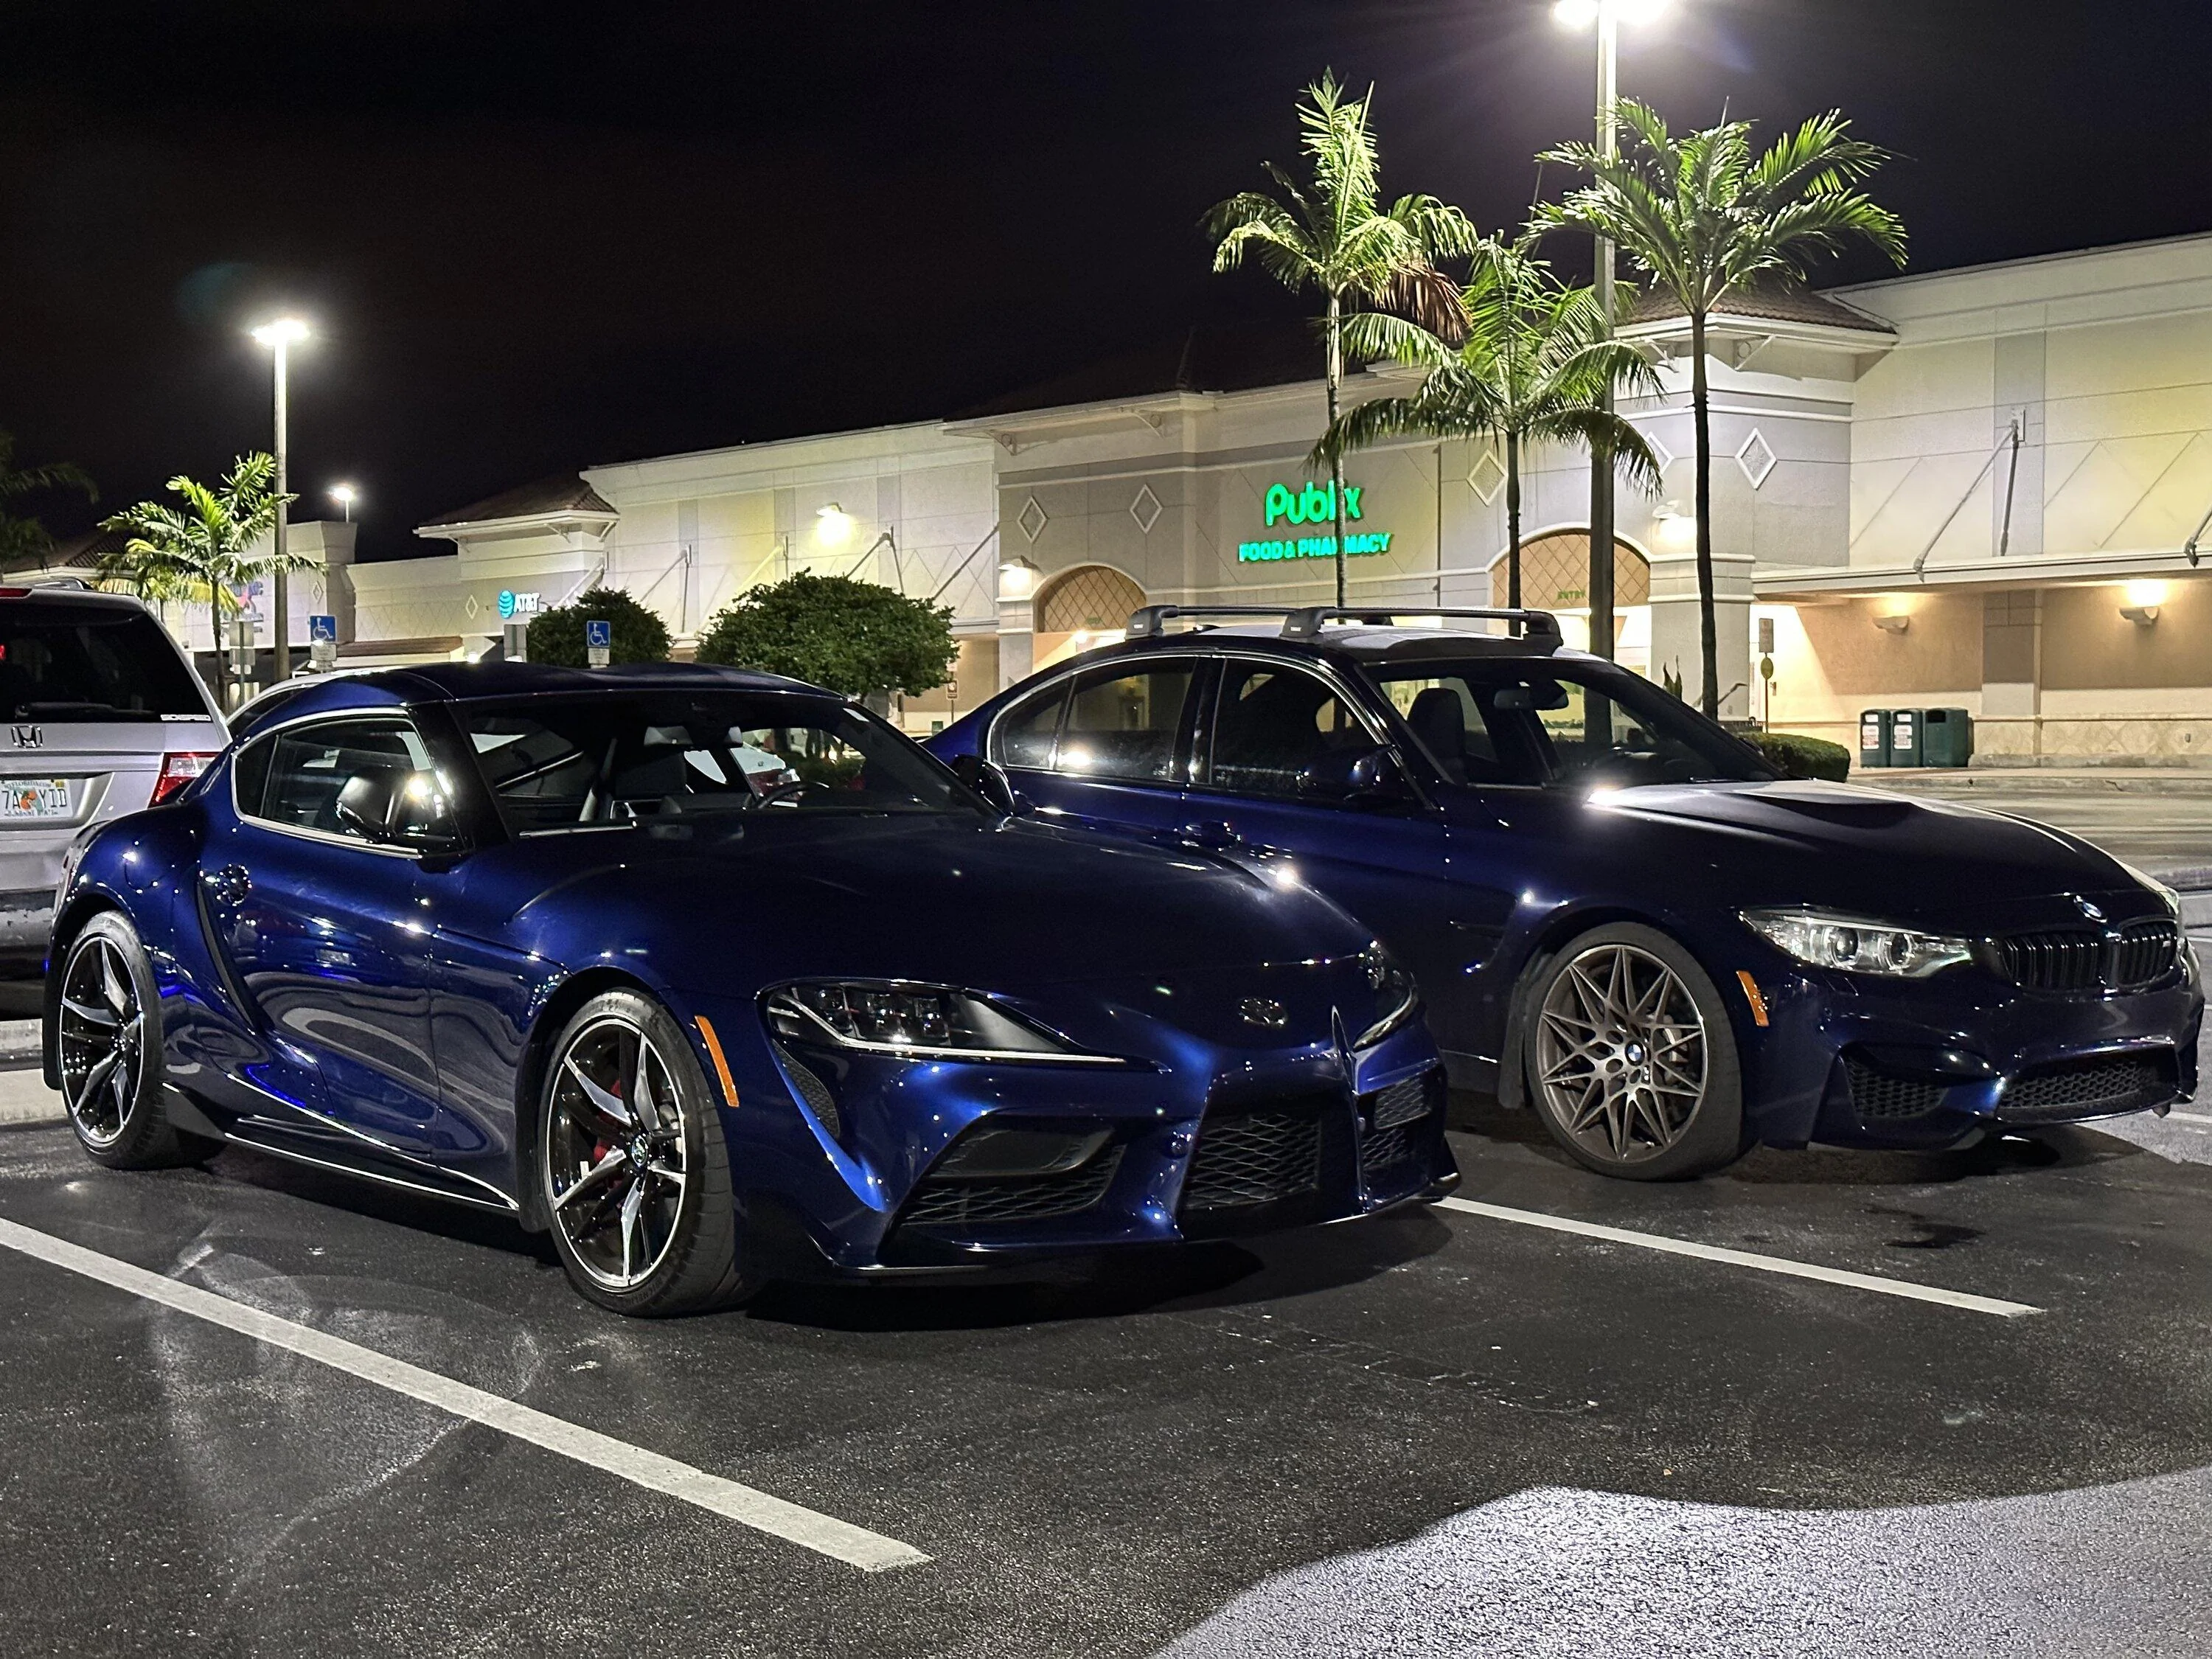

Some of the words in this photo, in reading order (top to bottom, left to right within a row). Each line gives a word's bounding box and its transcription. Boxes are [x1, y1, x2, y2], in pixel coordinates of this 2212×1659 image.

[1265, 480, 1361, 526] Publx
[1239, 541, 1283, 562] FOOD
[1284, 540, 1295, 559] &
[513, 592, 540, 613] AT&T
[38, 788, 67, 809] YID
